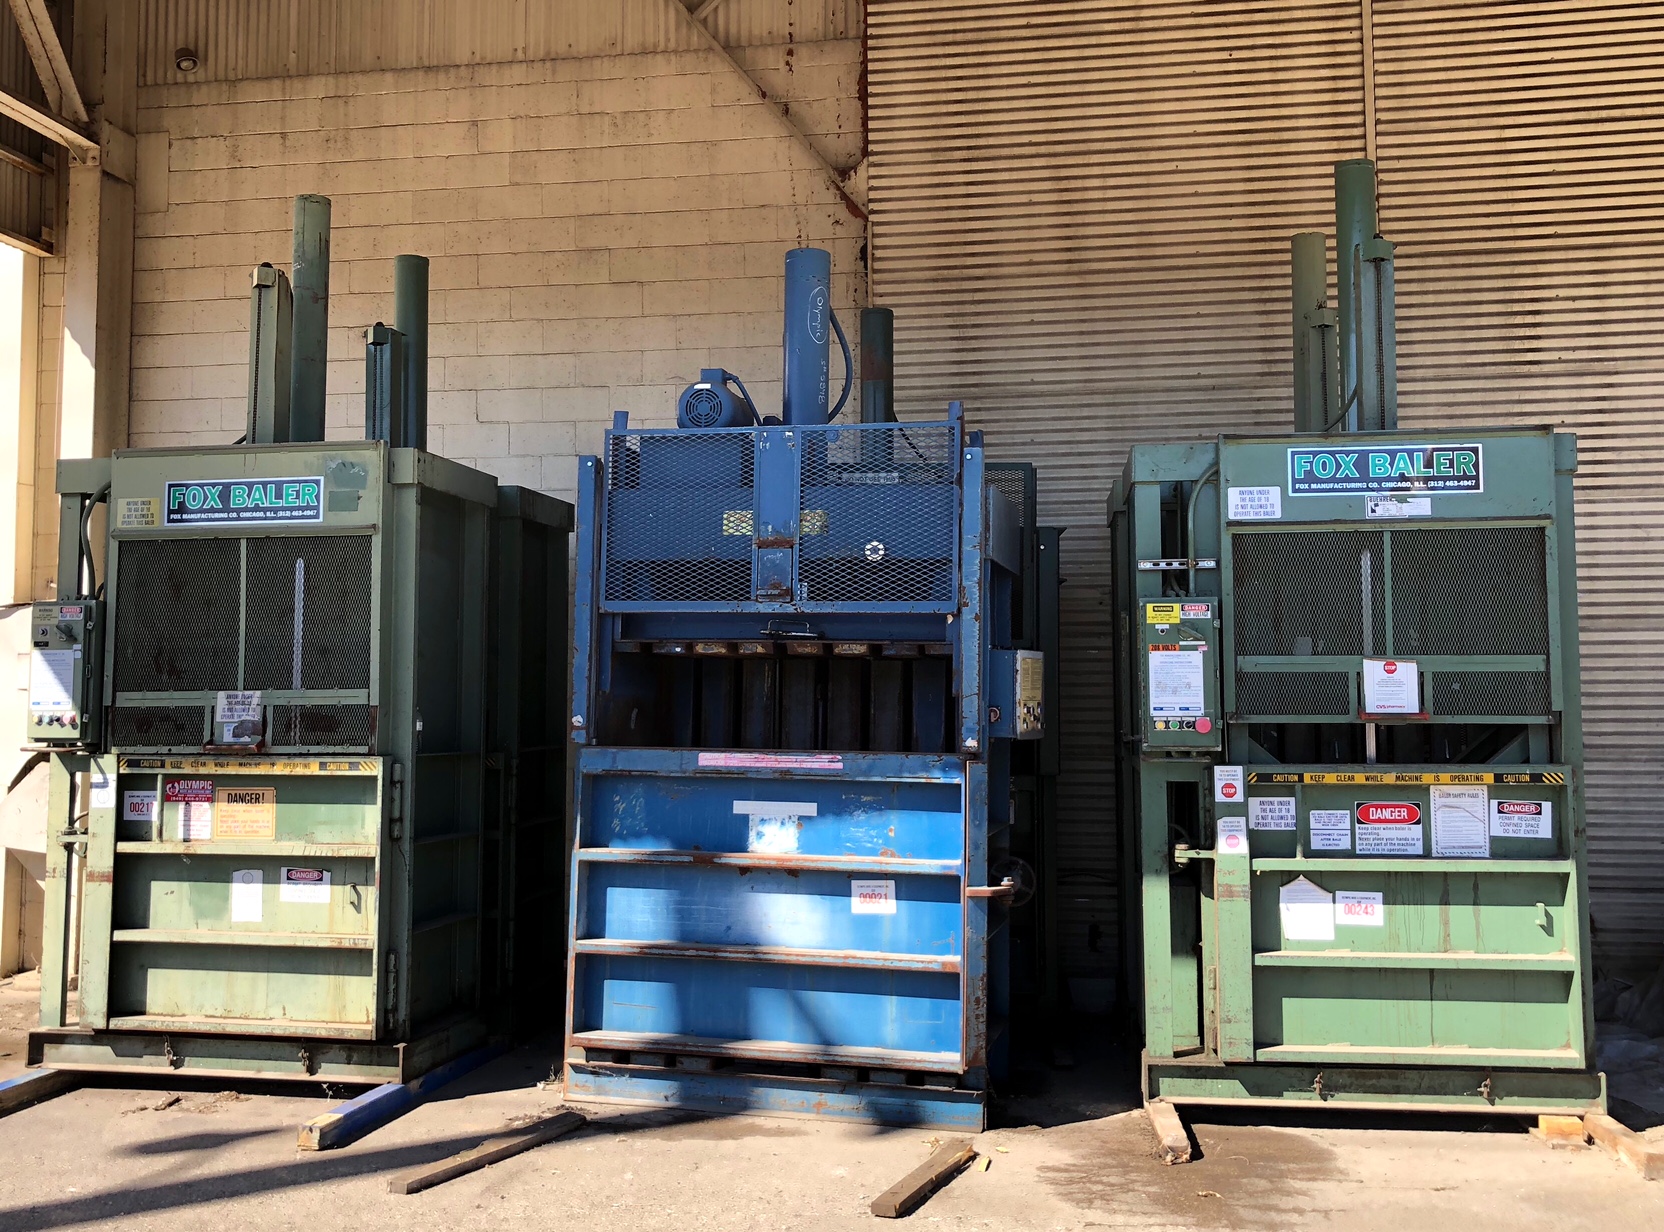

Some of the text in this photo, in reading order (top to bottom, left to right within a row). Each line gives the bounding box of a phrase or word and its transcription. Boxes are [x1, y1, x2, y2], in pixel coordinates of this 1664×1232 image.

[812, 296, 824, 338] Olympic
[1294, 451, 1476, 478] FOX BALER
[1428, 480, 1444, 488] (312)
[170, 483, 318, 510] FOX BALER
[180, 780, 212, 789] OLYMPIC
[227, 792, 265, 804] DANGER!
[1370, 808, 1408, 820] DANGER
[859, 892, 888, 904] 00021
[1344, 904, 1374, 916] 00243
